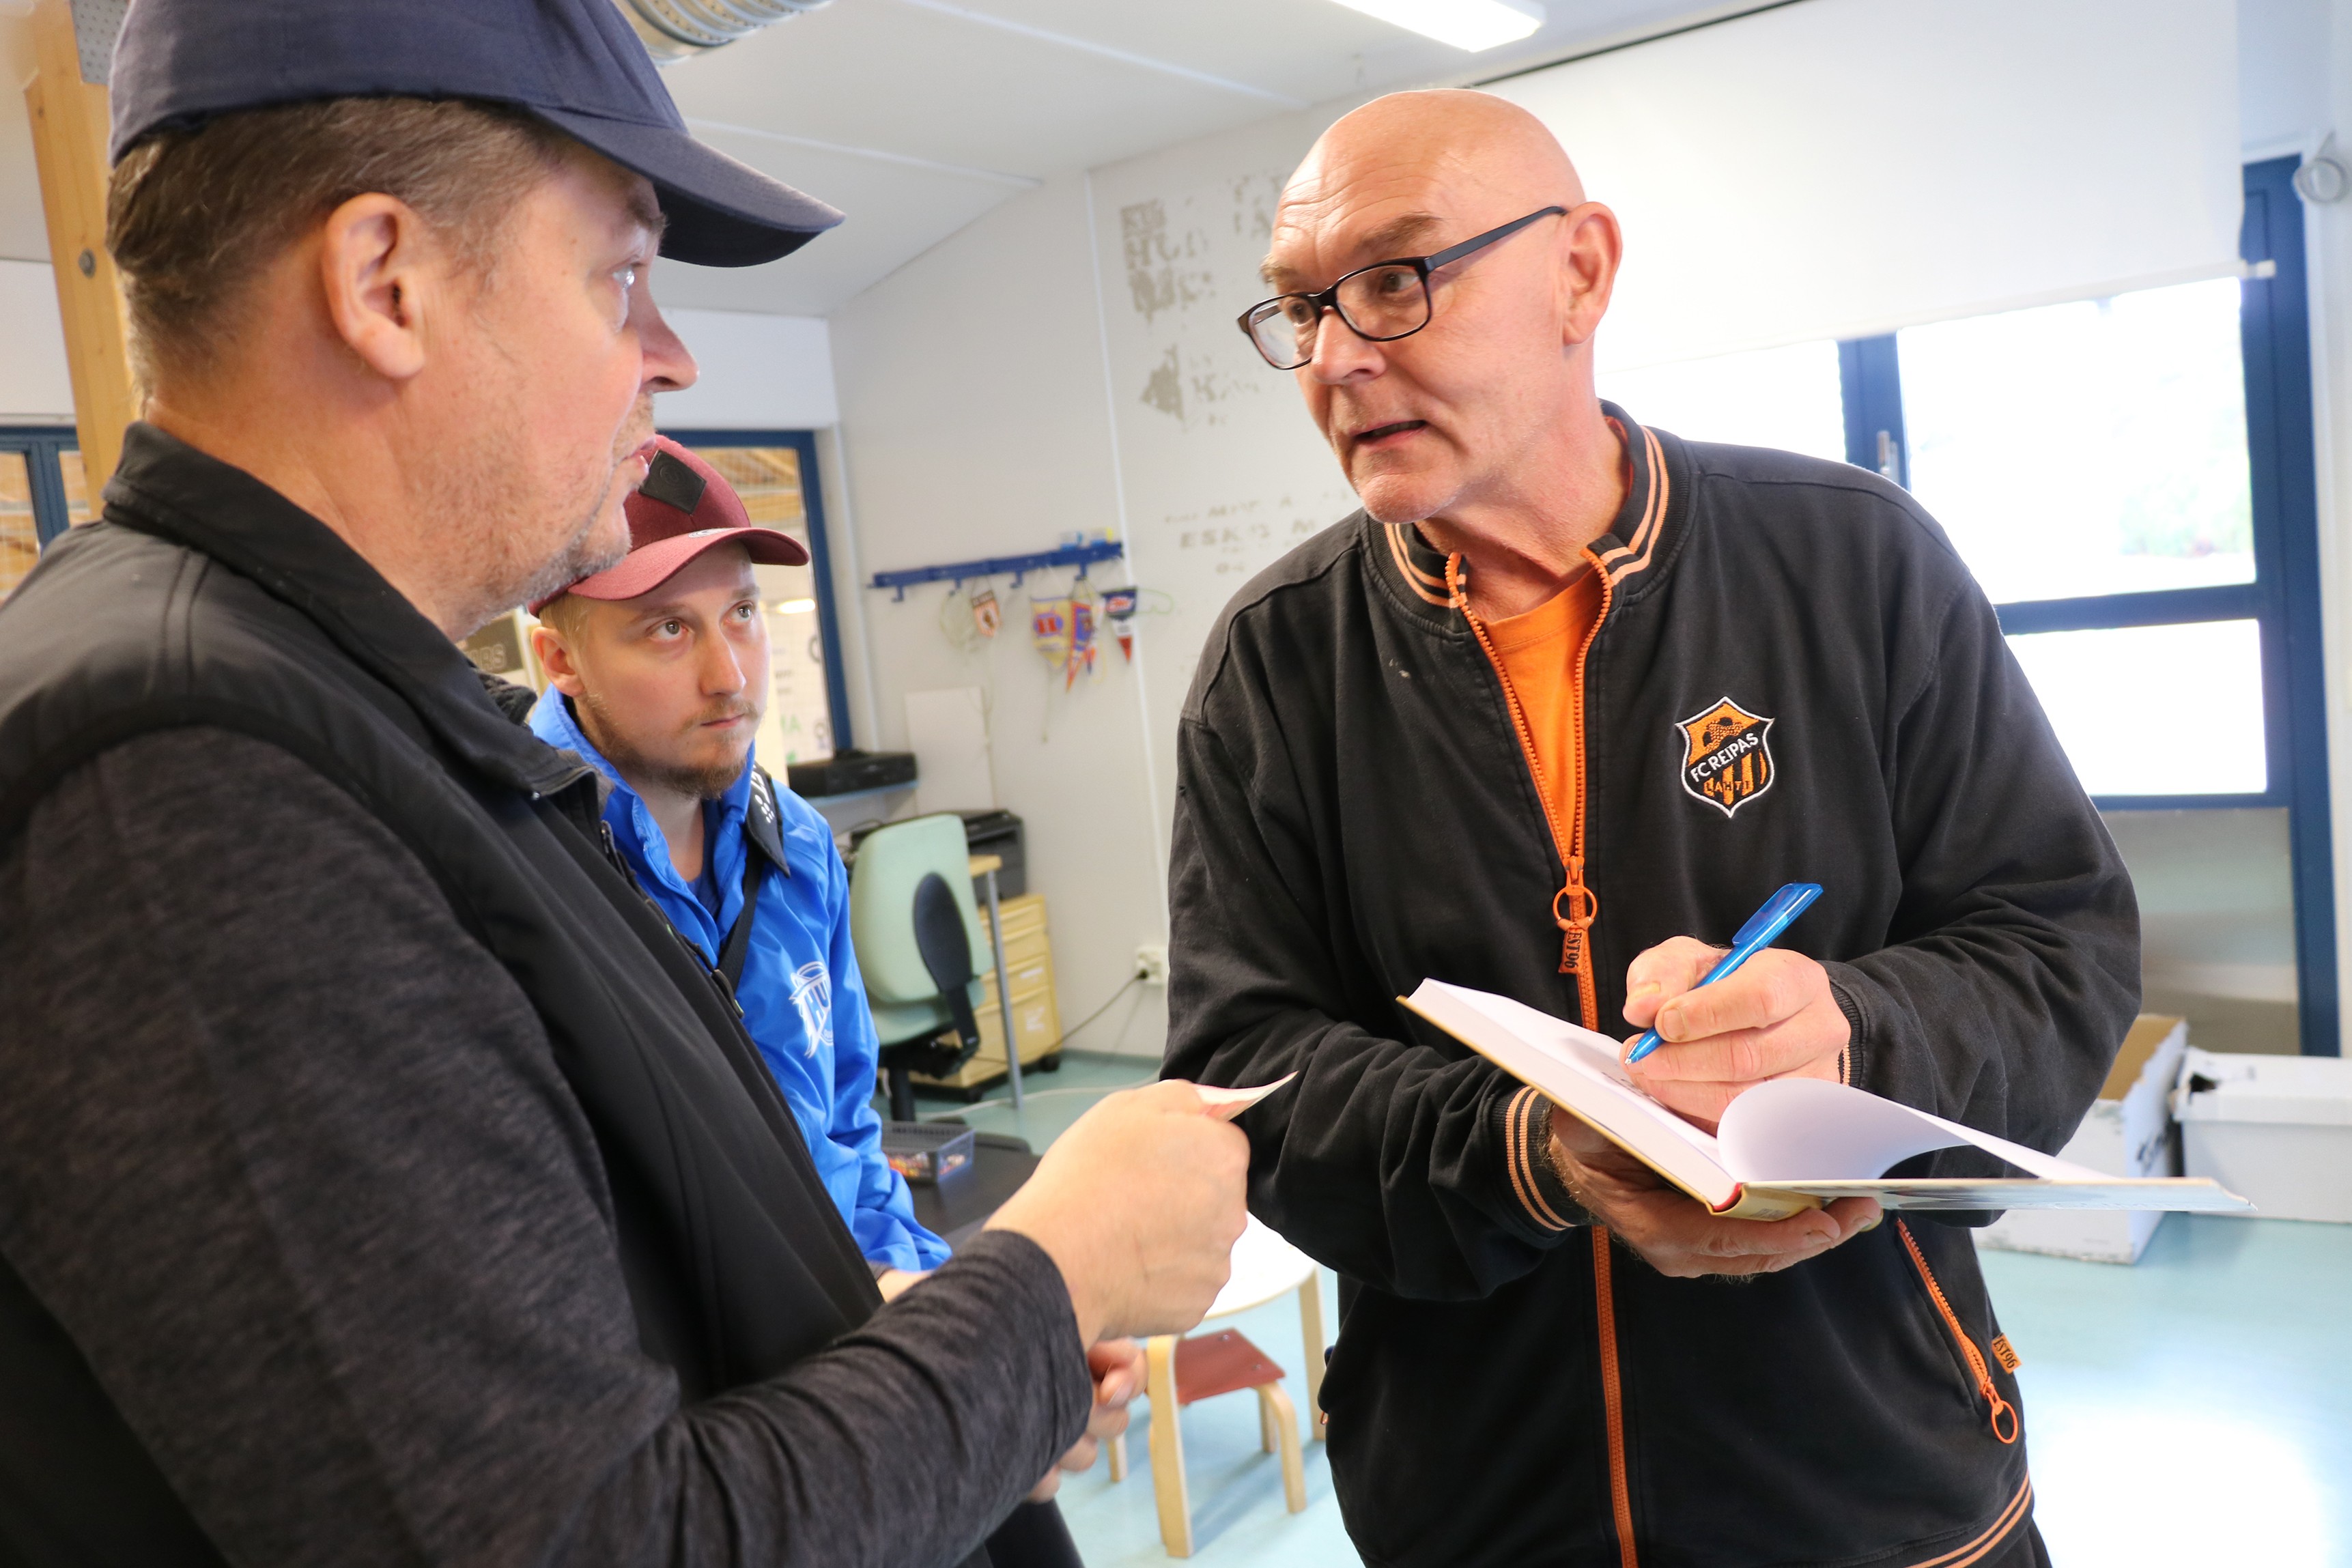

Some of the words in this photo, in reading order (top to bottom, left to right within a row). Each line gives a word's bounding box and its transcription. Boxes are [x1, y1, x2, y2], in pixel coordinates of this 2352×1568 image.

[1690, 762, 1711, 782] FC
[1708, 732, 1759, 771] REIPAS
[1706, 780, 1751, 793] LAHTI
[1564, 931, 1583, 969] EST96
[1993, 1338, 2018, 1369] EST96
